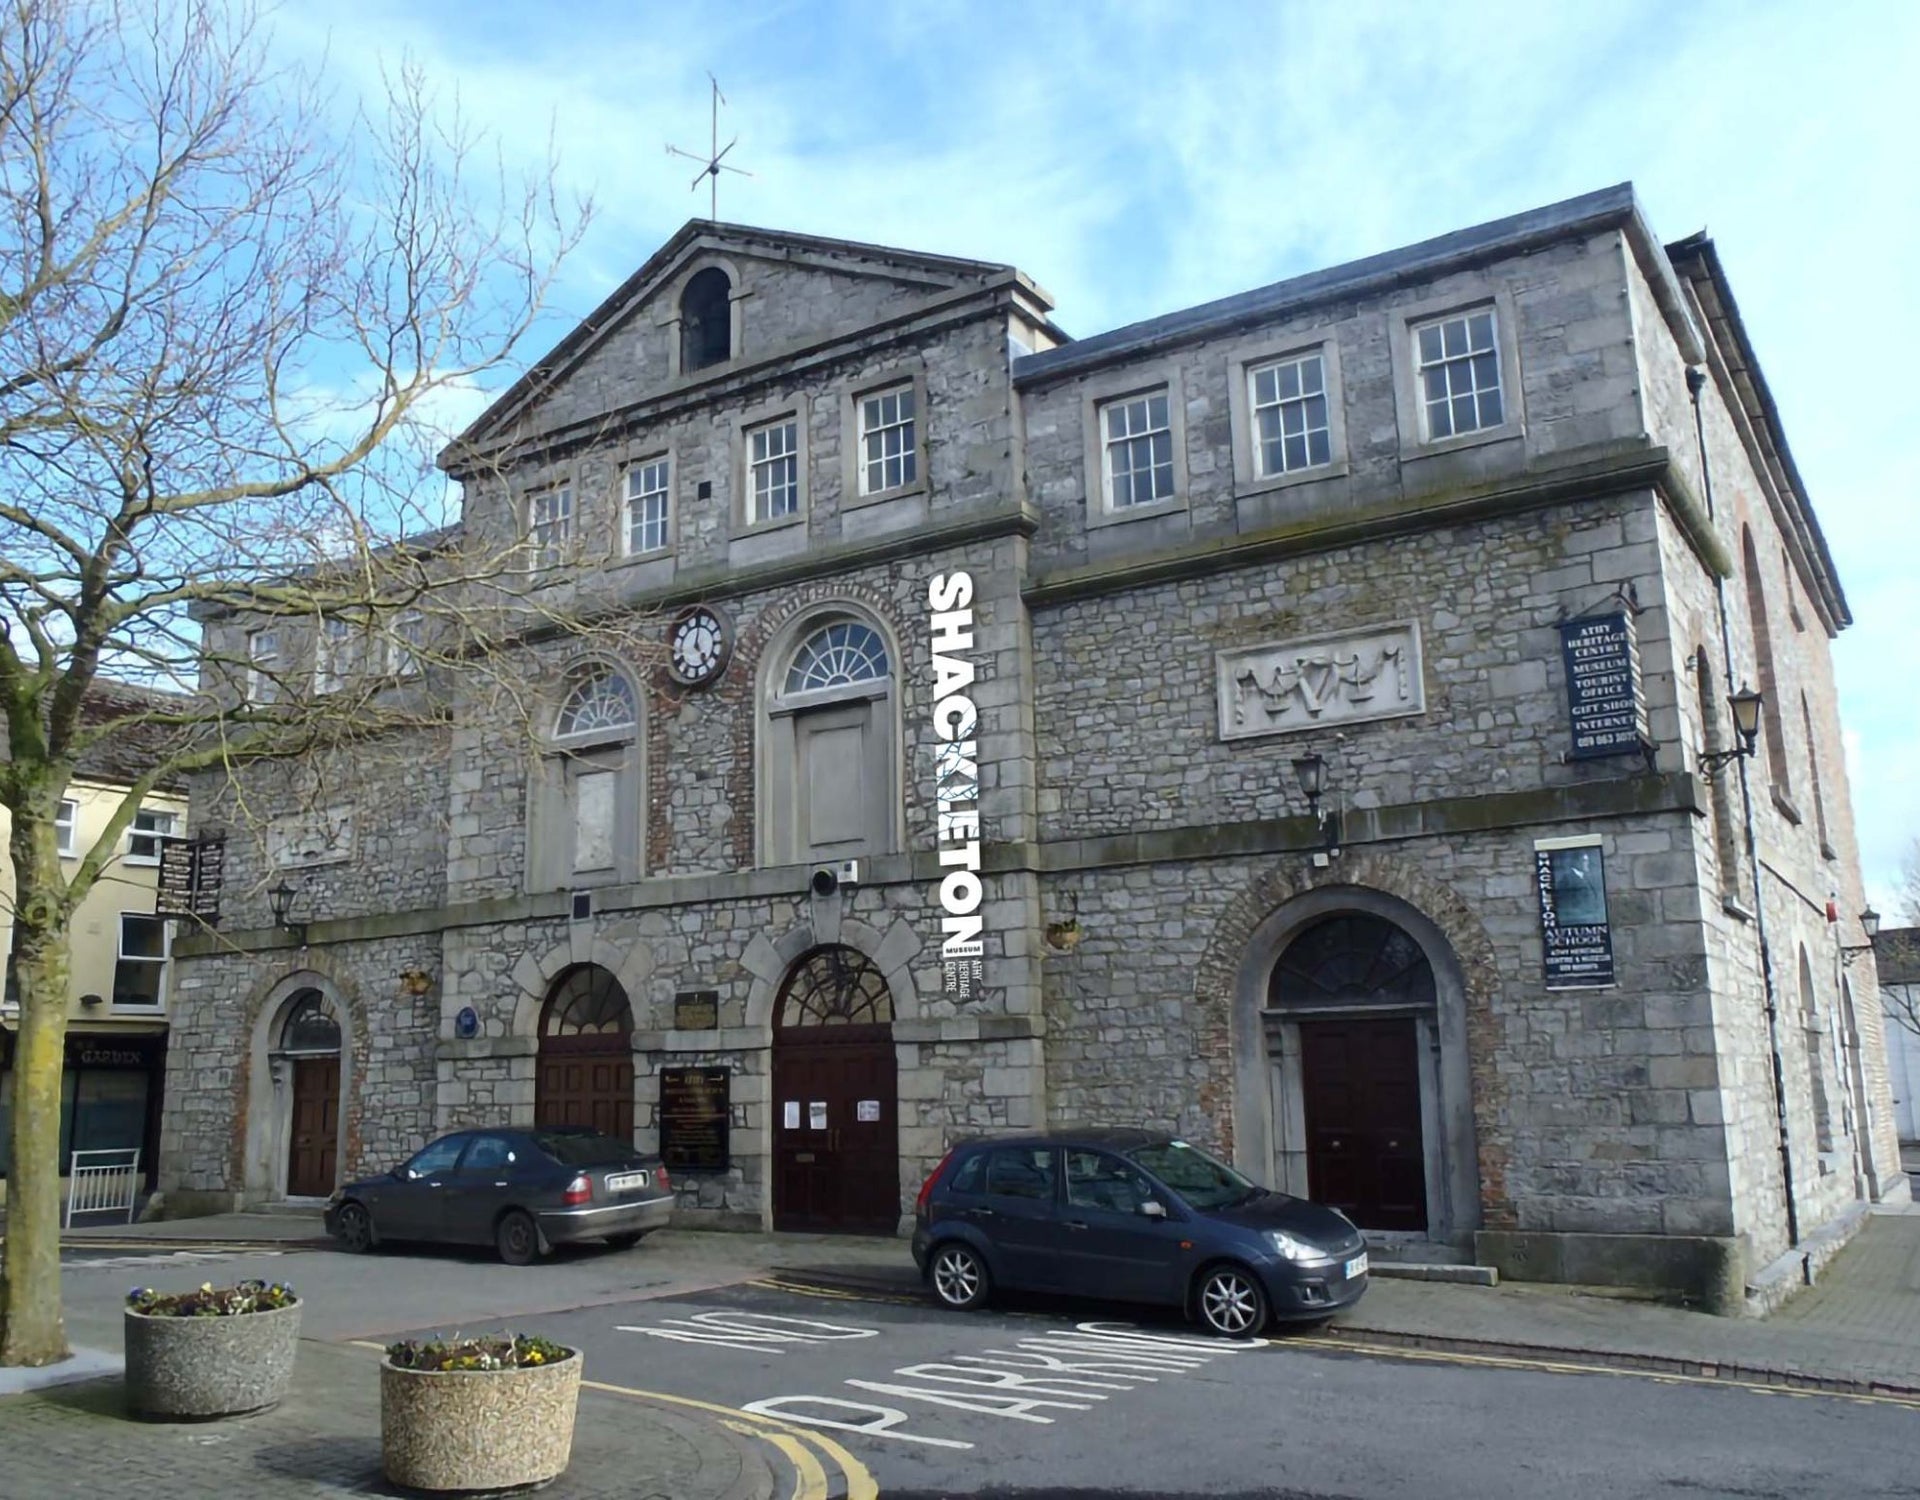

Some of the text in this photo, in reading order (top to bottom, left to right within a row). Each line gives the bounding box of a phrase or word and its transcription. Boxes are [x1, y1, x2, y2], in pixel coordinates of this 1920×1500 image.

[1580, 624, 1610, 636] ATHY
[1568, 632, 1625, 648] HERITAGE
[1575, 644, 1620, 657] CENTRE
[1573, 658, 1627, 673] MUSEUM
[1575, 673, 1627, 688] TOURIST
[1581, 685, 1623, 697] OFFICE
[1572, 704, 1599, 715] GIFT
[1576, 715, 1634, 730] INTERNET
[928, 571, 983, 957] SHACKLETON
[1538, 852, 1555, 927] SHACKLETON
[1545, 925, 1607, 938] AUTUMN
[1547, 936, 1606, 948] SCHOOL
[945, 946, 980, 954] MUSEUM
[945, 961, 957, 990] CENTRE
[972, 960, 982, 980] ATHY
[959, 960, 970, 998] HERITAGE
[740, 1321, 1269, 1448] PARKING
